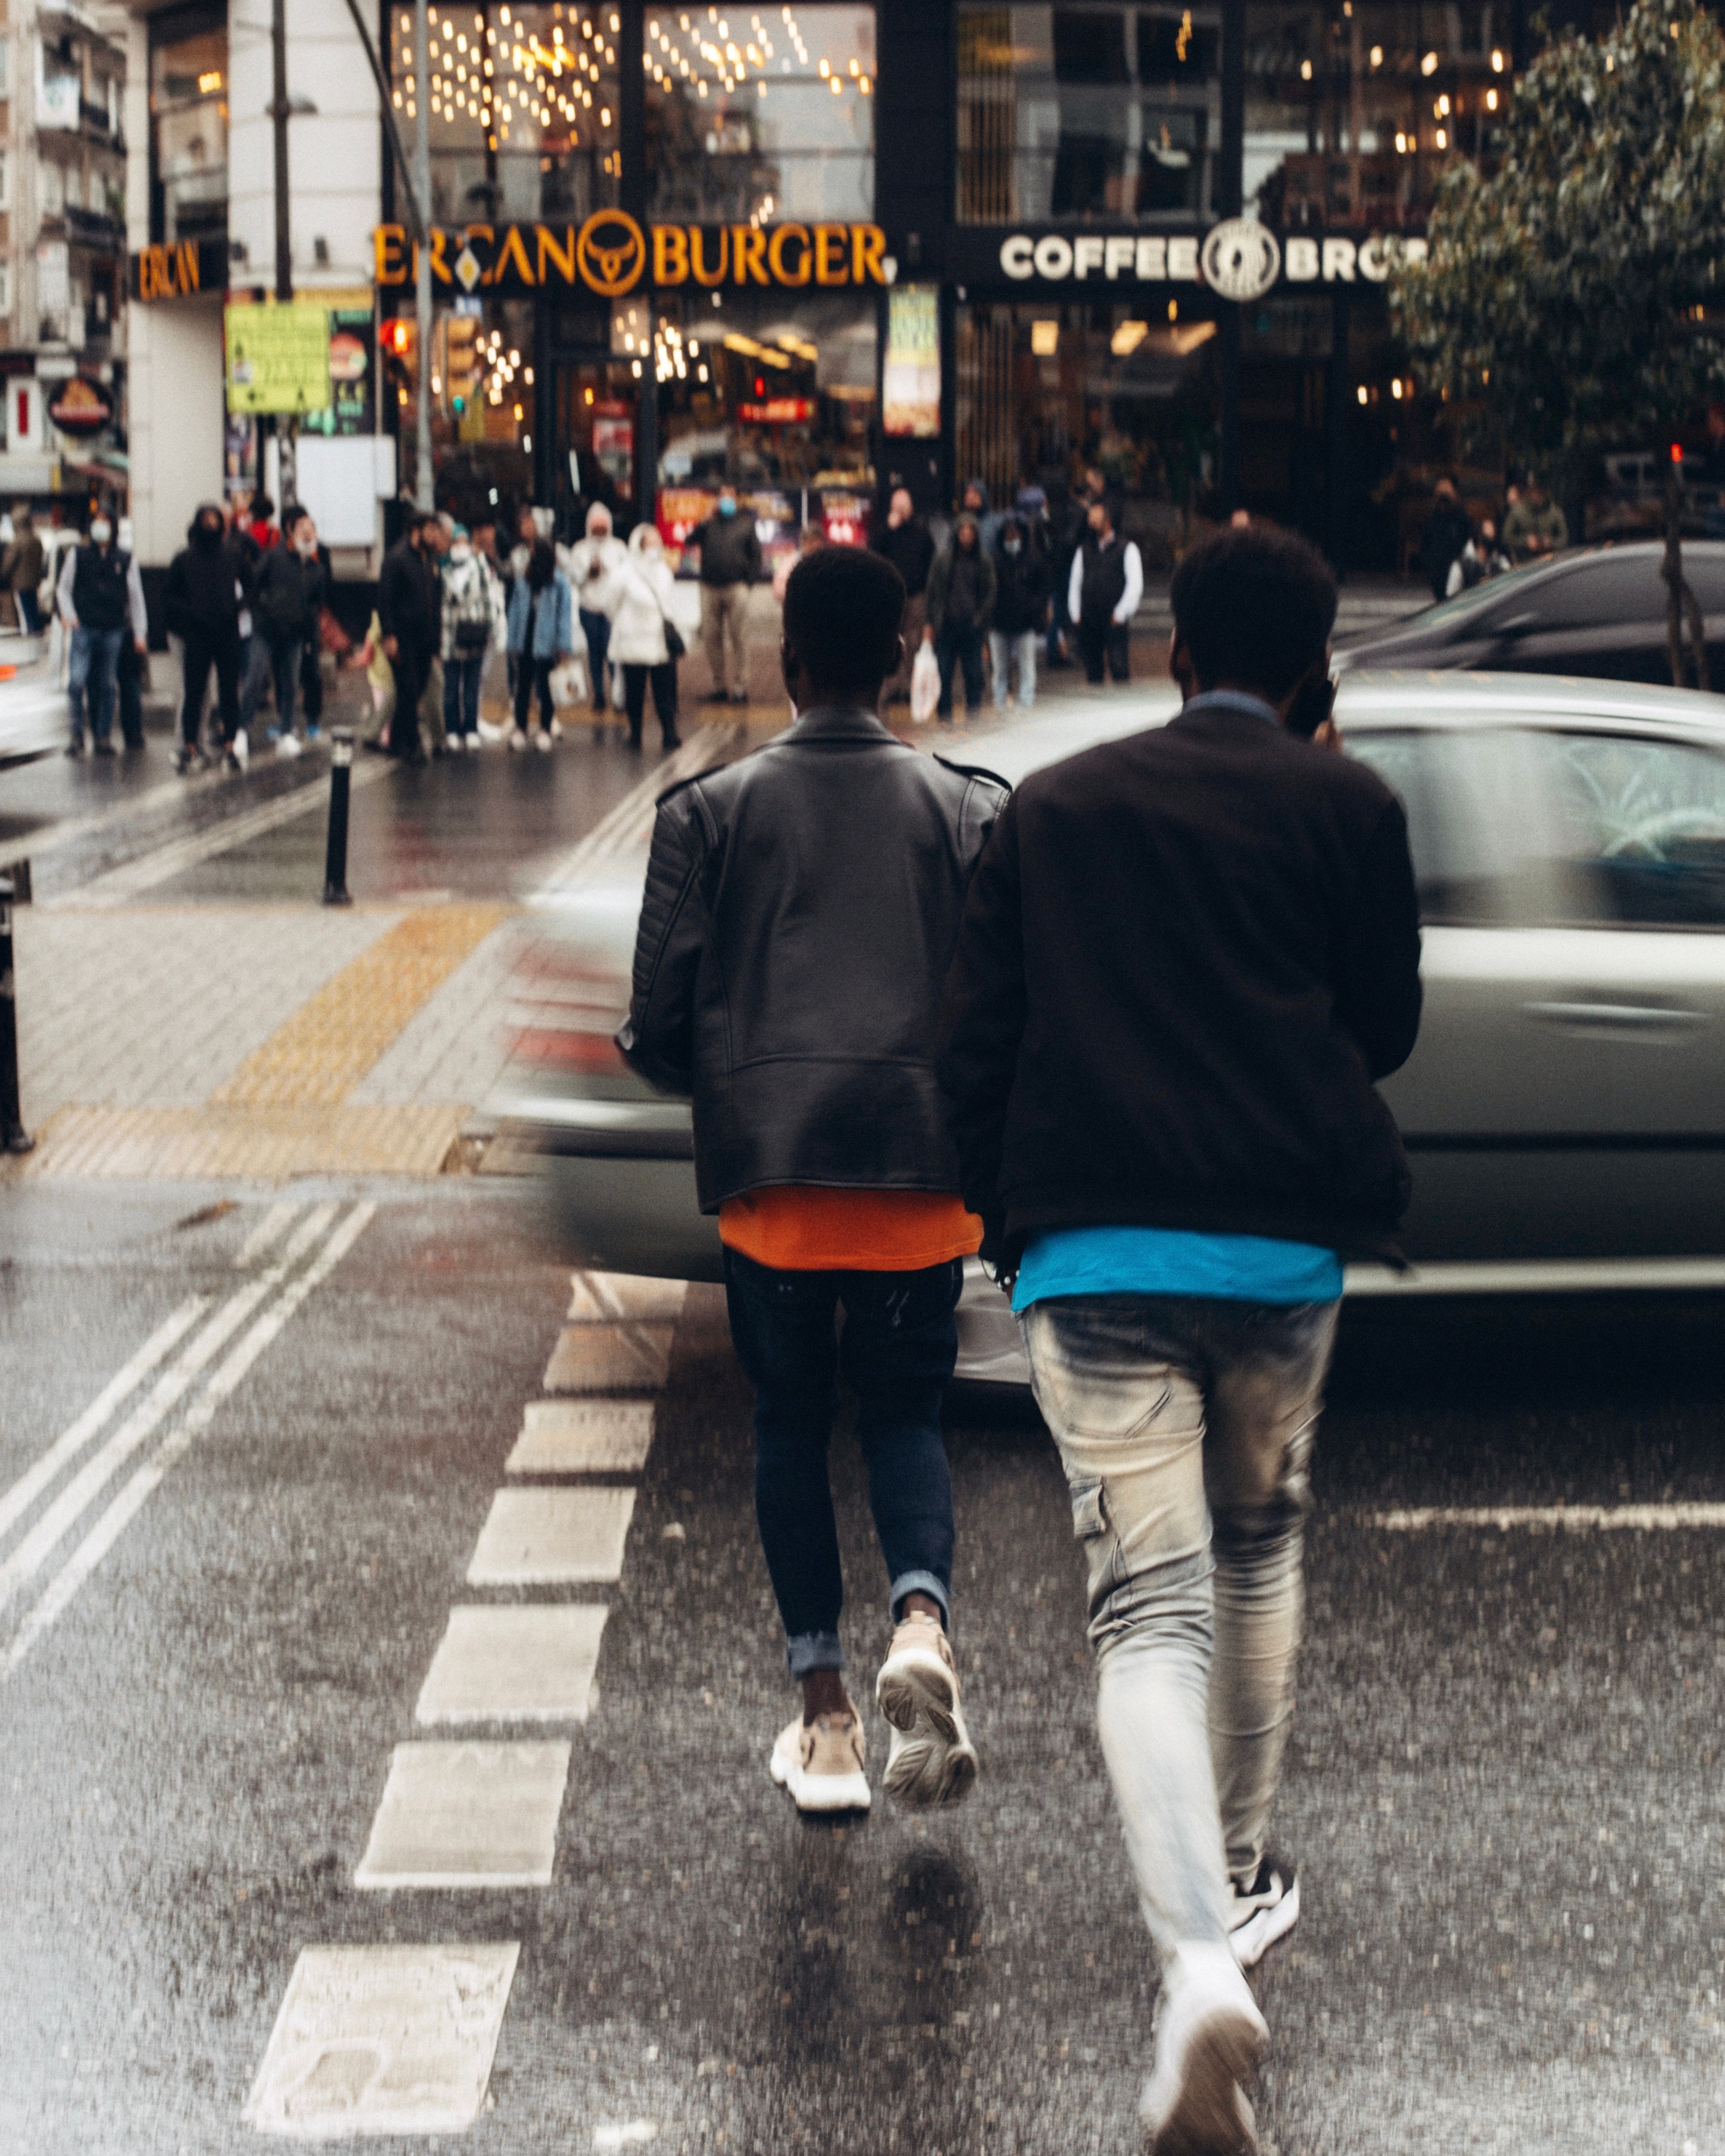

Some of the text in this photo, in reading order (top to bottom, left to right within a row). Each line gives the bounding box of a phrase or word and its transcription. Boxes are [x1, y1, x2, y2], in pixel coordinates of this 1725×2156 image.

[373, 222, 888, 286] ERCAN BURGER
[999, 234, 1199, 281] COFFEE
